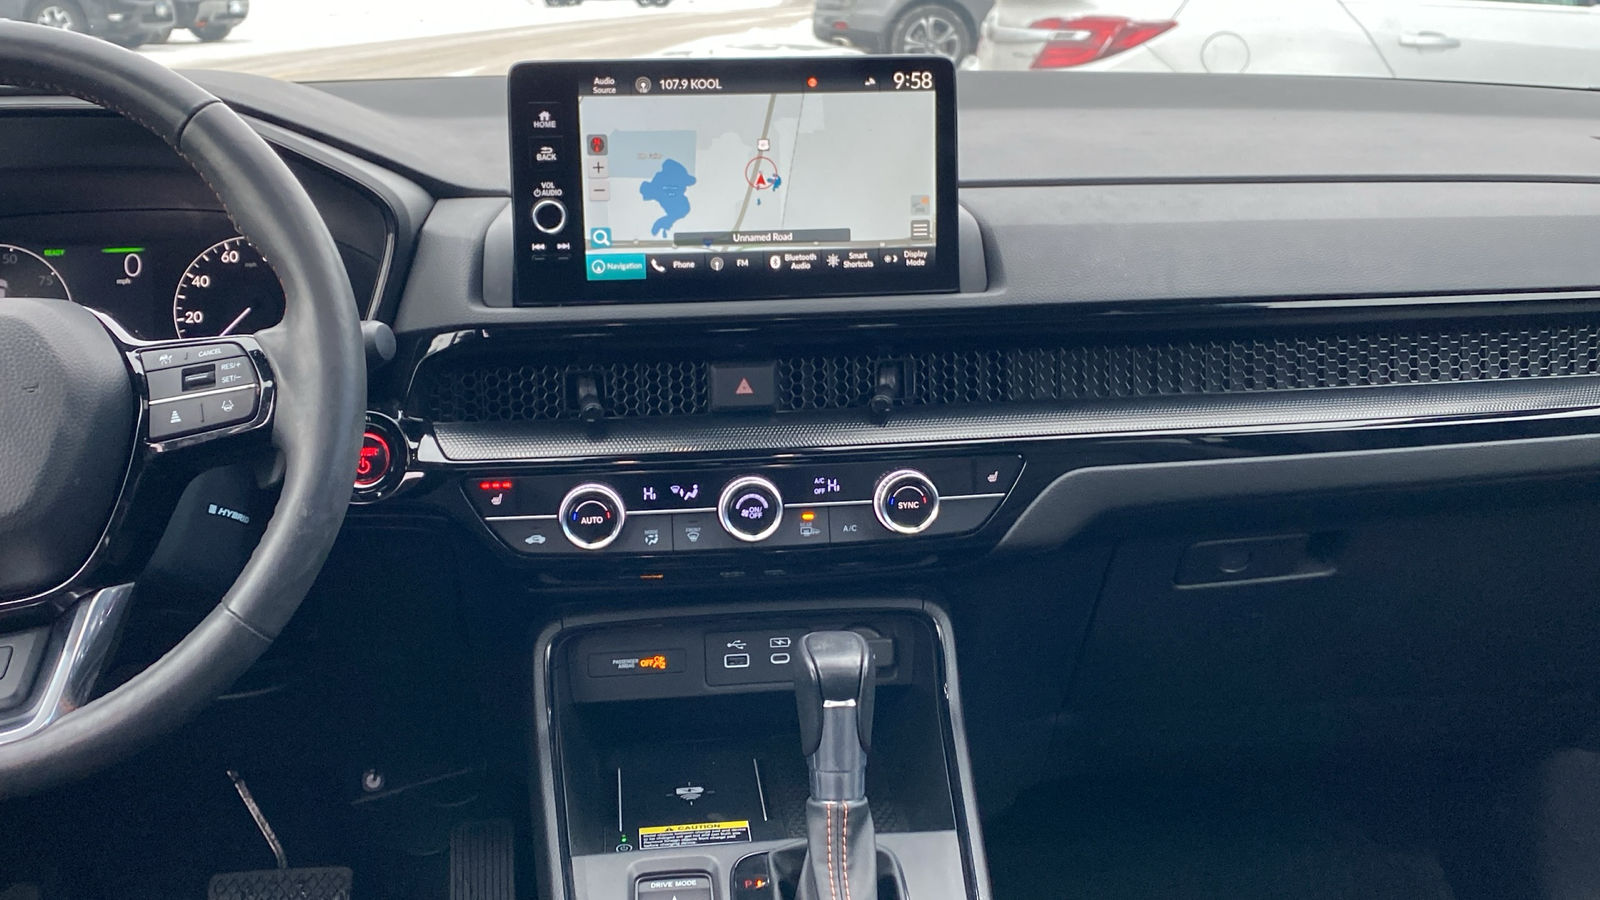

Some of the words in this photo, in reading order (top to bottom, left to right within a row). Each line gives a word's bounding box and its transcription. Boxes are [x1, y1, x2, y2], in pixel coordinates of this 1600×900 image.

[594, 76, 615, 85] Audio
[659, 79, 688, 90] 107.9
[690, 79, 723, 90] KOOL
[893, 72, 933, 89] 9:58
[592, 86, 617, 94] Source
[533, 120, 557, 128] HOME
[536, 153, 557, 161] BACK
[541, 181, 555, 189] VOL
[541, 189, 563, 197] AUDIO
[733, 232, 772, 243] Unnamed
[773, 232, 793, 242] Road
[2, 253, 18, 264] 50
[221, 250, 239, 263] 60
[784, 253, 817, 262] Bluetooth
[849, 252, 868, 260] Smart
[904, 250, 928, 261] Display
[124, 253, 142, 277] 0
[607, 262, 643, 271] Navigation
[673, 260, 696, 269] Phone
[736, 259, 749, 267] FM
[790, 262, 811, 270] Audio
[843, 260, 874, 269] Shortcuts
[906, 258, 926, 267] Mode
[38, 275, 54, 287] 75
[191, 275, 210, 288] 40
[185, 311, 203, 324] 20
[198, 348, 222, 358] CANCEL
[897, 501, 920, 510] SYNC
[217, 506, 250, 524] HYBRID
[580, 516, 604, 525] AUTO
[842, 524, 857, 532] A/C
[677, 823, 721, 831] CAUTION
[650, 881, 673, 889] DRIVE
[675, 879, 697, 888] MODE
[744, 880, 753, 889] P
